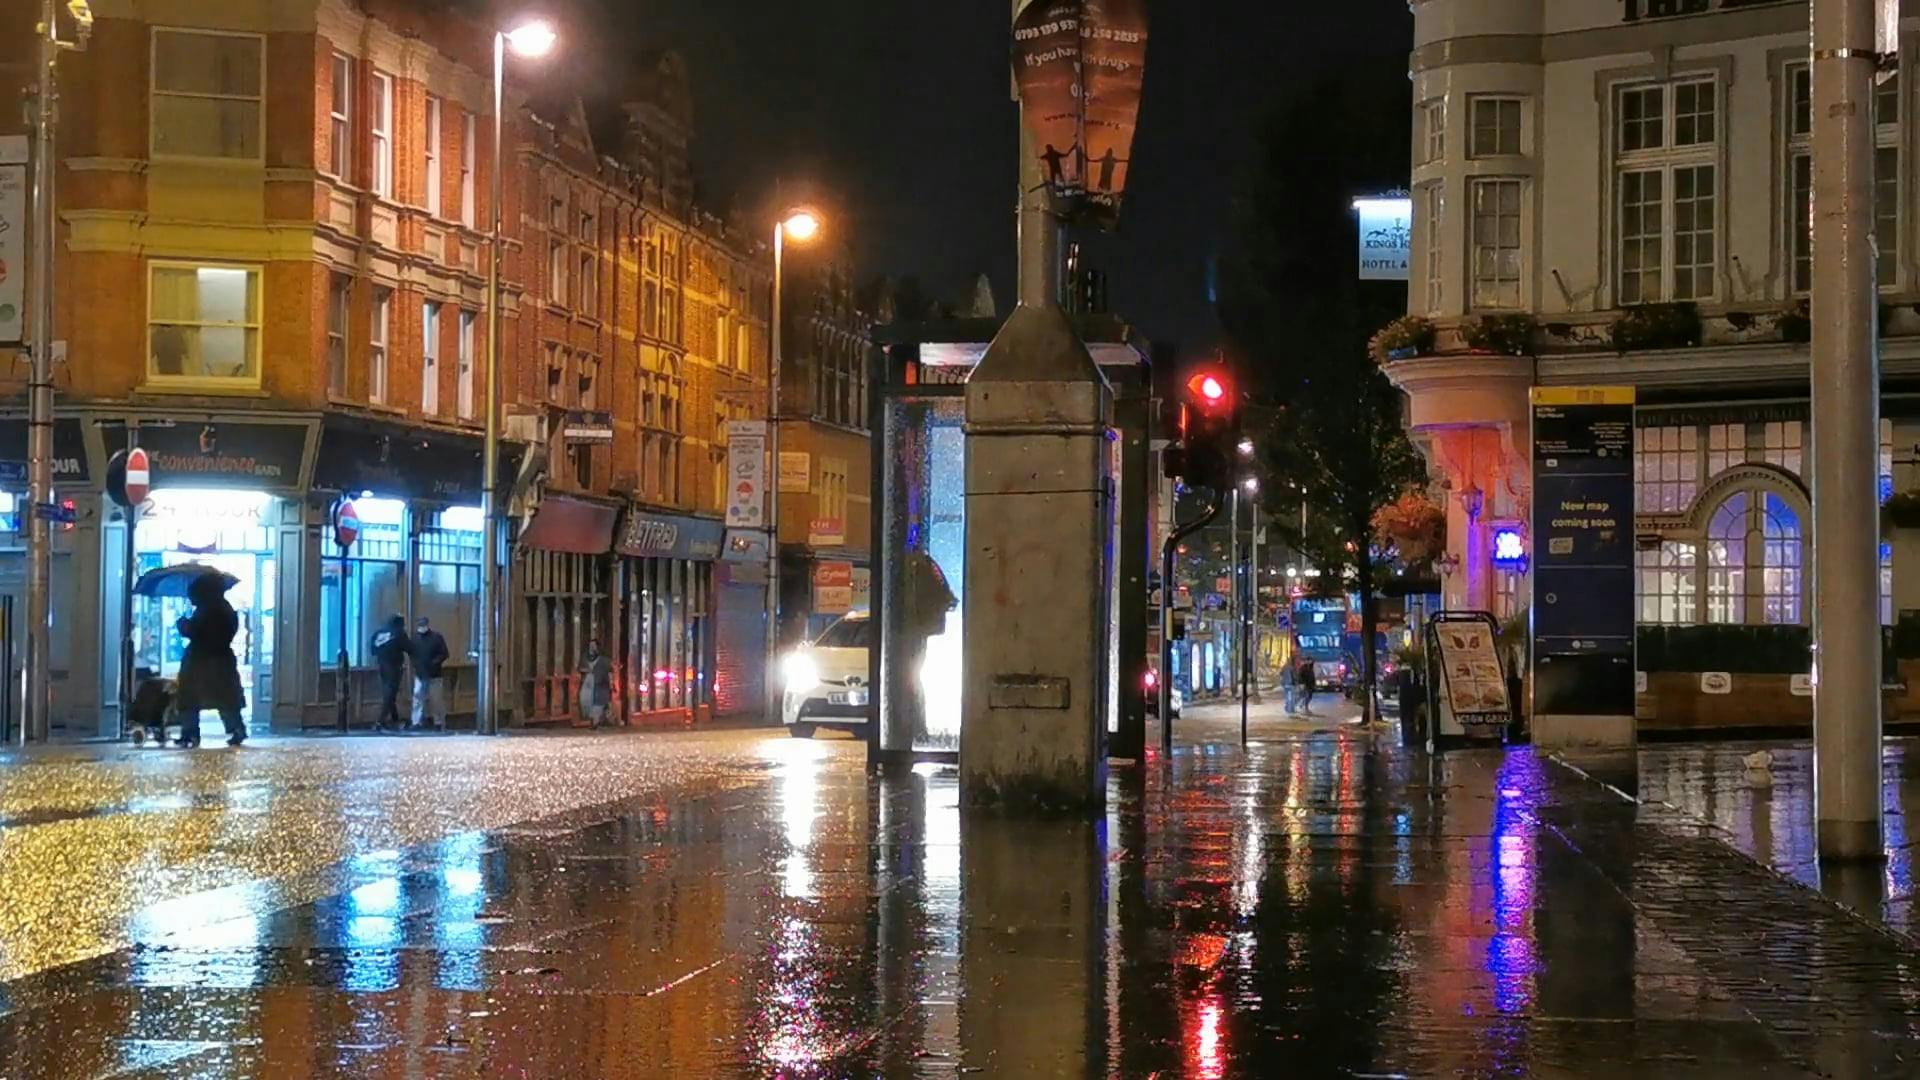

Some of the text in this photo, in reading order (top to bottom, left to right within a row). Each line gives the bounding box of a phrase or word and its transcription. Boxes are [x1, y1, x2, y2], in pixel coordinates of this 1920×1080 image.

[1057, 47, 1078, 58] hav
[1364, 240, 1397, 249] KINGS
[1362, 260, 1397, 269] HOTEL
[51, 458, 80, 473] OUR
[160, 452, 257, 474] convenience
[1561, 501, 1609, 513] New map
[1551, 517, 1616, 529] coming soon
